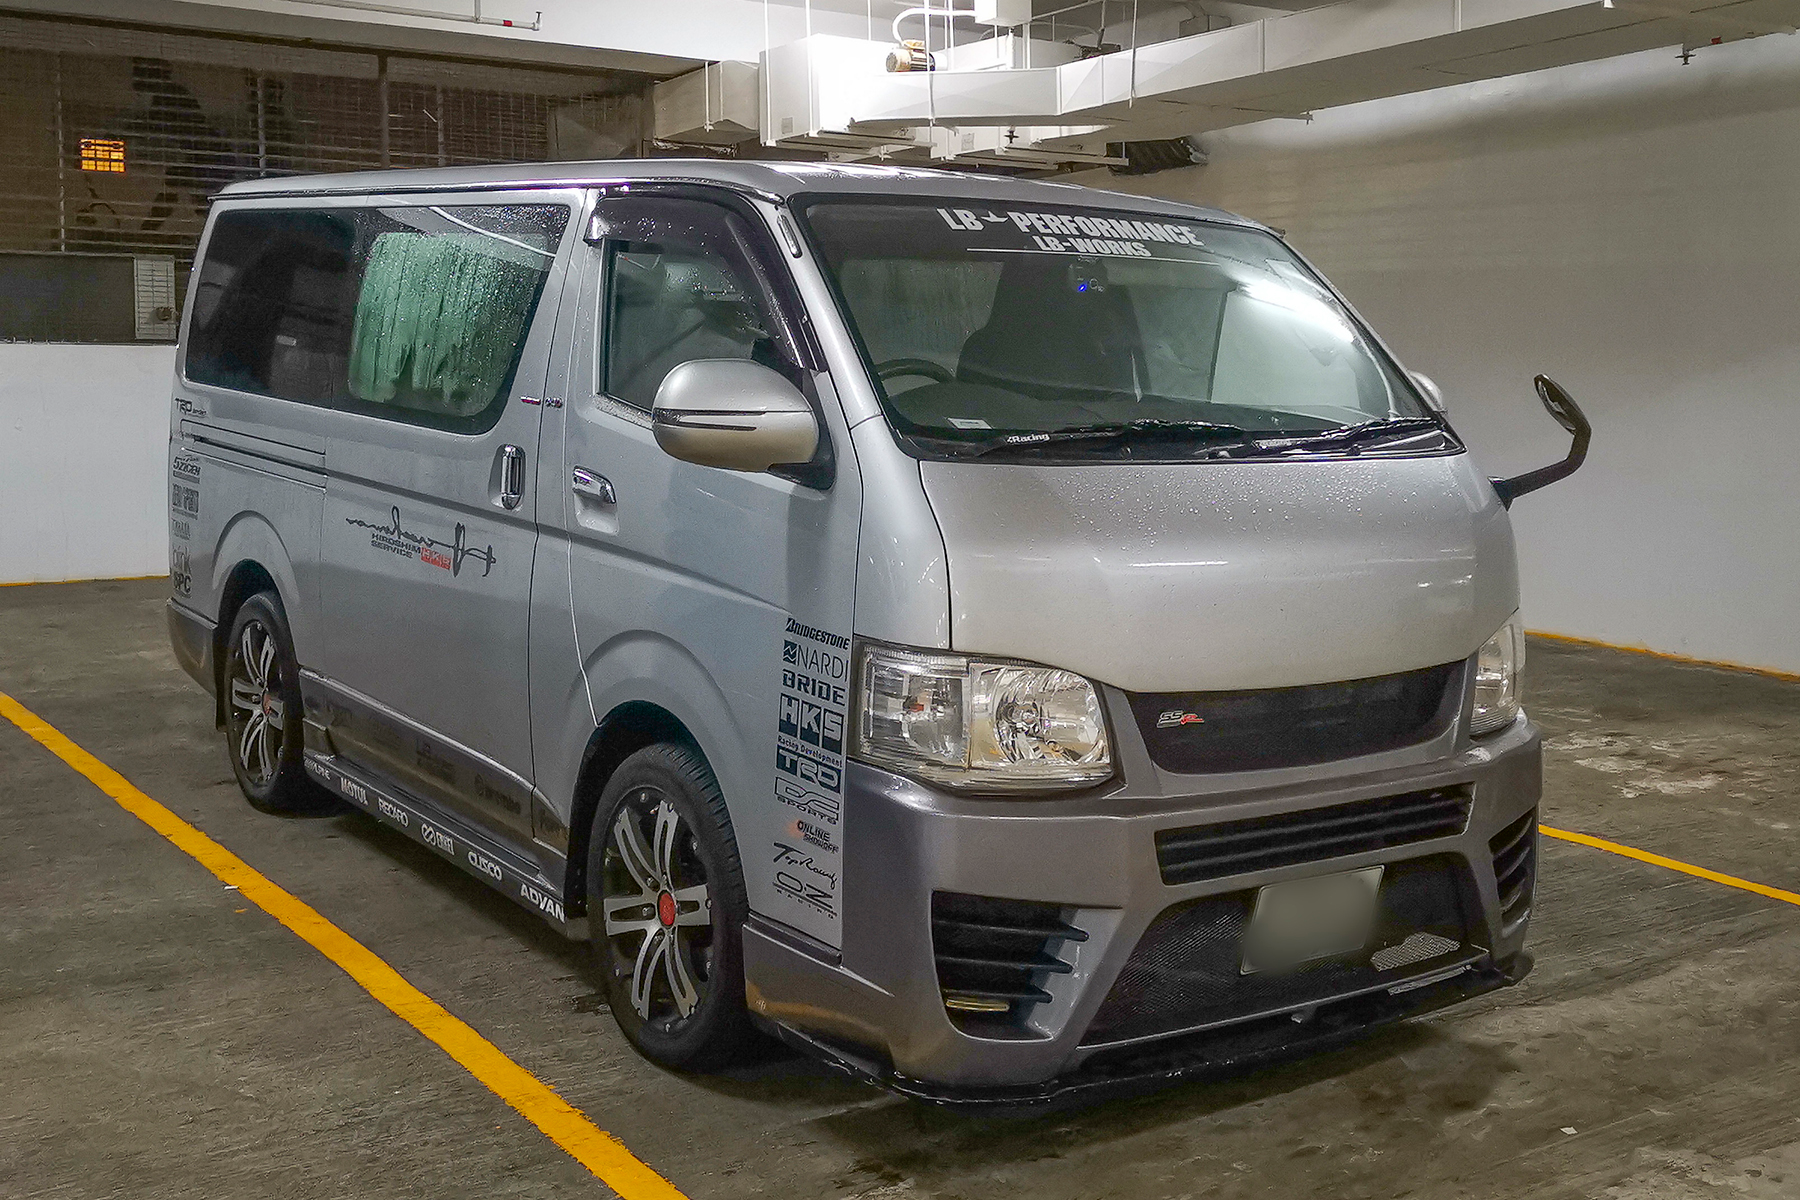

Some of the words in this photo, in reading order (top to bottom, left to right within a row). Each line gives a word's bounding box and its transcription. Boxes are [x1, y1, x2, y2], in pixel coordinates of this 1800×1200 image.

[937, 208, 985, 231] LB
[1006, 211, 1205, 247] PERFORMANCE
[1031, 235, 1152, 257] LB-WORKS
[785, 617, 850, 651] BRIDGESTONE
[796, 645, 849, 682] NARDI
[782, 668, 846, 707] BRIDE
[778, 693, 844, 755] HKS
[775, 744, 842, 794] TRD
[797, 820, 831, 843] ONLINE
[467, 851, 502, 881] CUSCO
[520, 883, 566, 924] ADVAN
